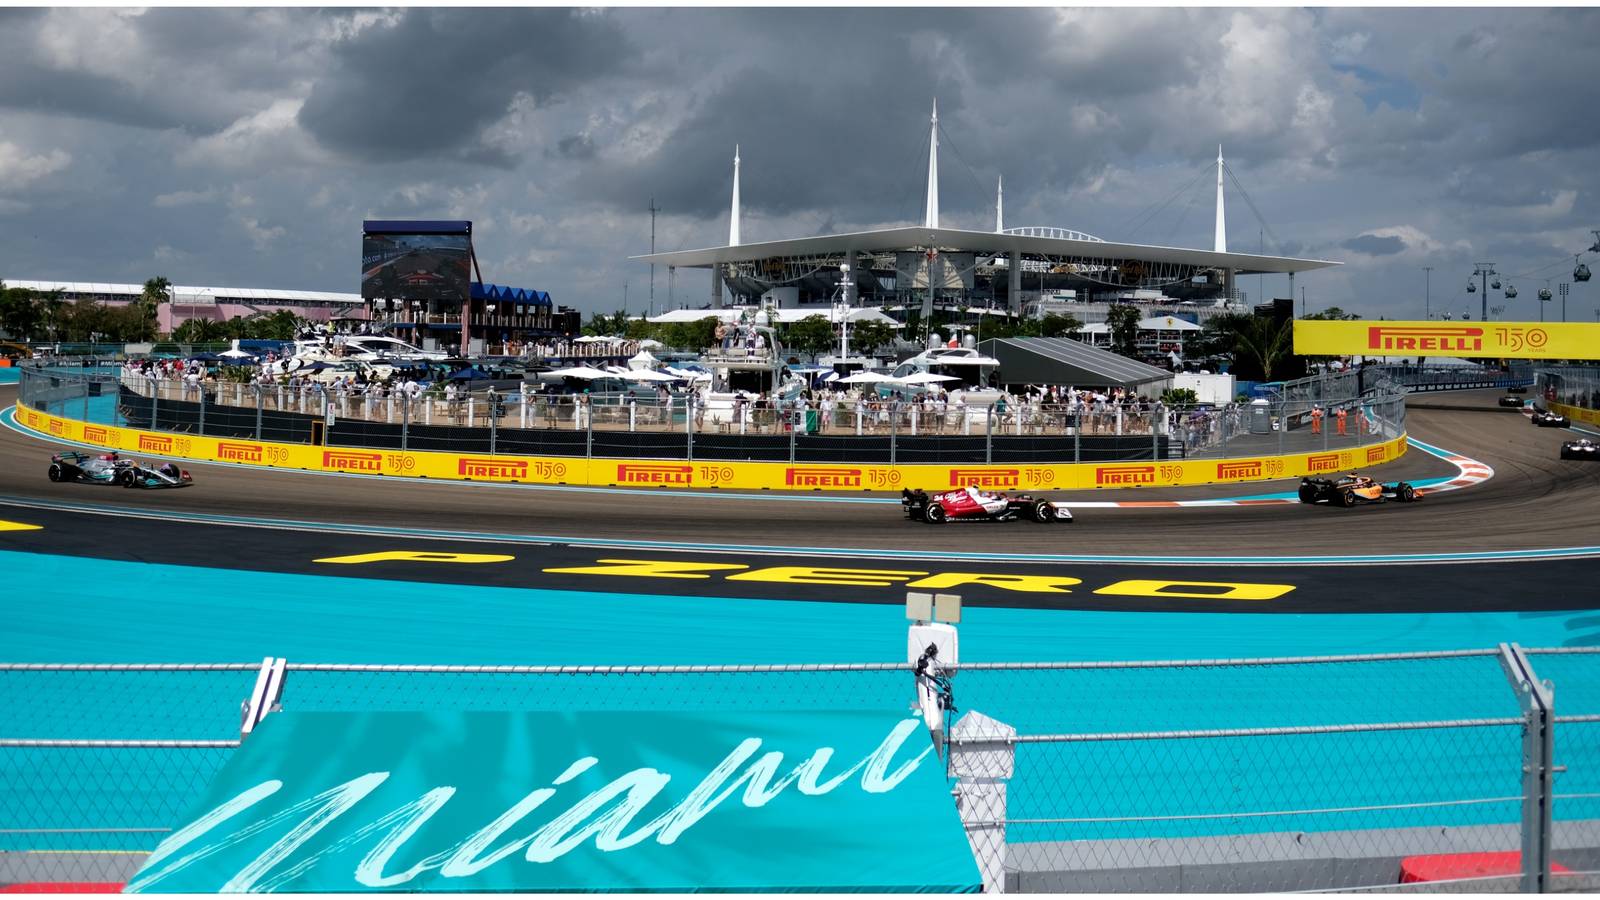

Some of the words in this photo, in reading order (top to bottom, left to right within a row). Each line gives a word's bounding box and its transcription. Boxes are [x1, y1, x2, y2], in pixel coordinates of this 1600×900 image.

[1368, 326, 1484, 351] PIRELLI
[1495, 327, 1548, 352] 150
[84, 426, 107, 443] PIRELLI
[139, 434, 173, 453] PIRELLI
[218, 442, 263, 462] PIRELLI
[323, 450, 383, 471] PIRELLI
[387, 455, 416, 472] 150
[458, 458, 529, 478] PIRELLI
[534, 461, 567, 479] 150
[1217, 460, 1262, 480] PIRELLI
[1308, 454, 1340, 472] PIRELLI
[617, 464, 693, 484] PIRELLI
[700, 466, 734, 485] 150
[785, 468, 862, 487] PIRELLI
[868, 469, 902, 488] 150
[950, 469, 1020, 487] PIRELLI
[1025, 469, 1055, 486] 150
[1096, 466, 1155, 485] PIRELLI
[1159, 465, 1183, 481] 150
[313, 550, 515, 566] P
[543, 558, 1299, 602] ZERO
[122, 709, 932, 894] Miami
